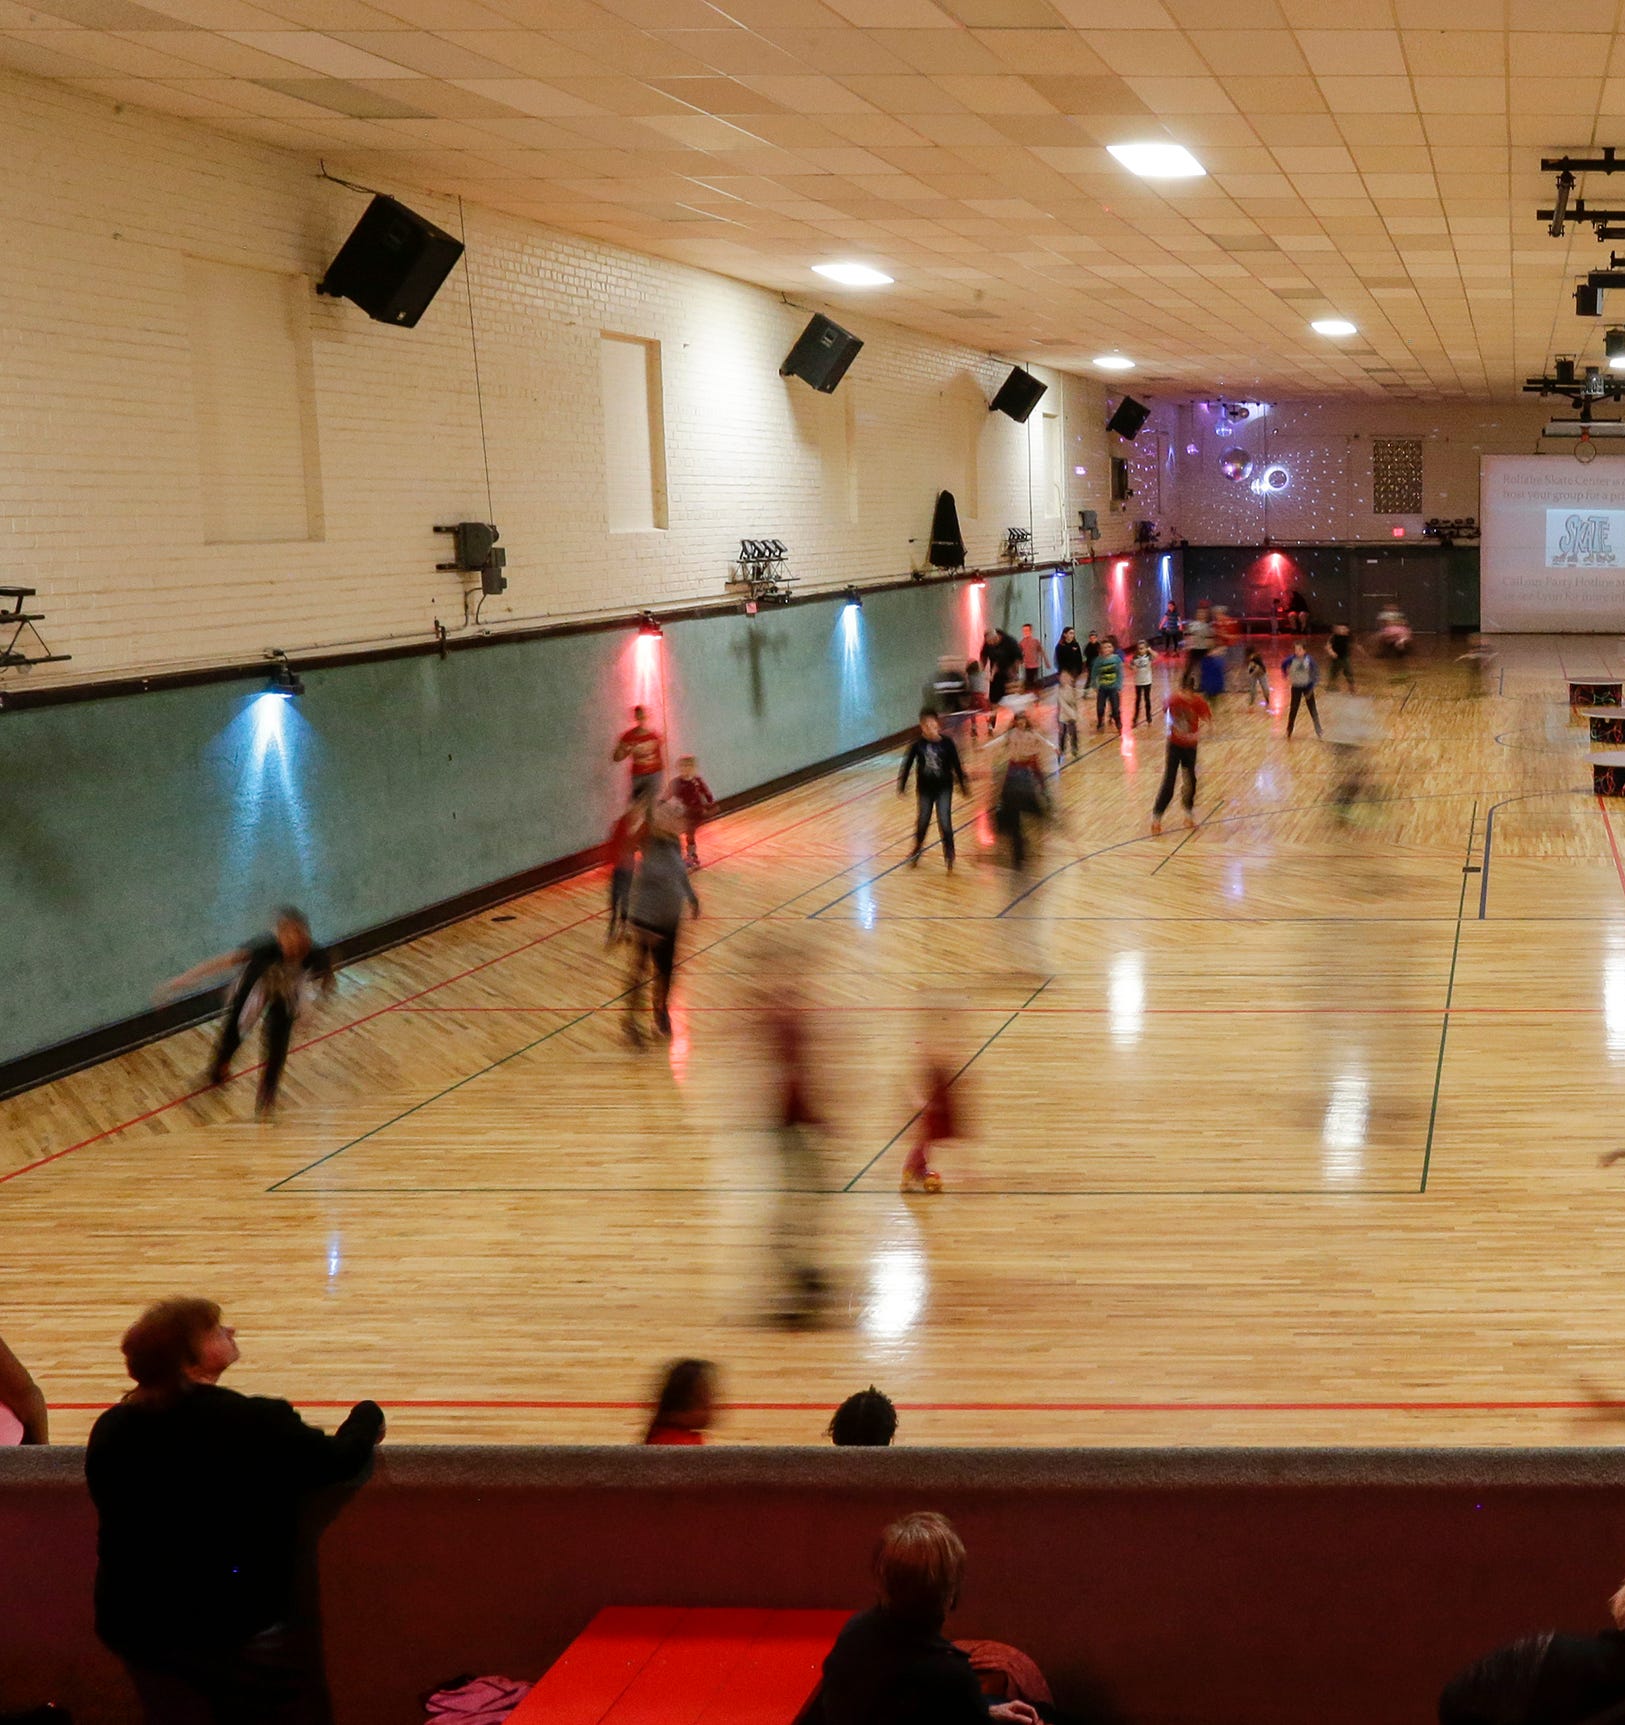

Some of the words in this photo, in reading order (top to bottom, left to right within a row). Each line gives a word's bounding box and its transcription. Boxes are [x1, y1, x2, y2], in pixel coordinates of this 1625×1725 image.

[1545, 474, 1572, 487] Skate
[1575, 475, 1609, 487] Center
[1527, 491, 1551, 501] your
[1552, 491, 1584, 503] group
[1559, 514, 1612, 553] SKATE
